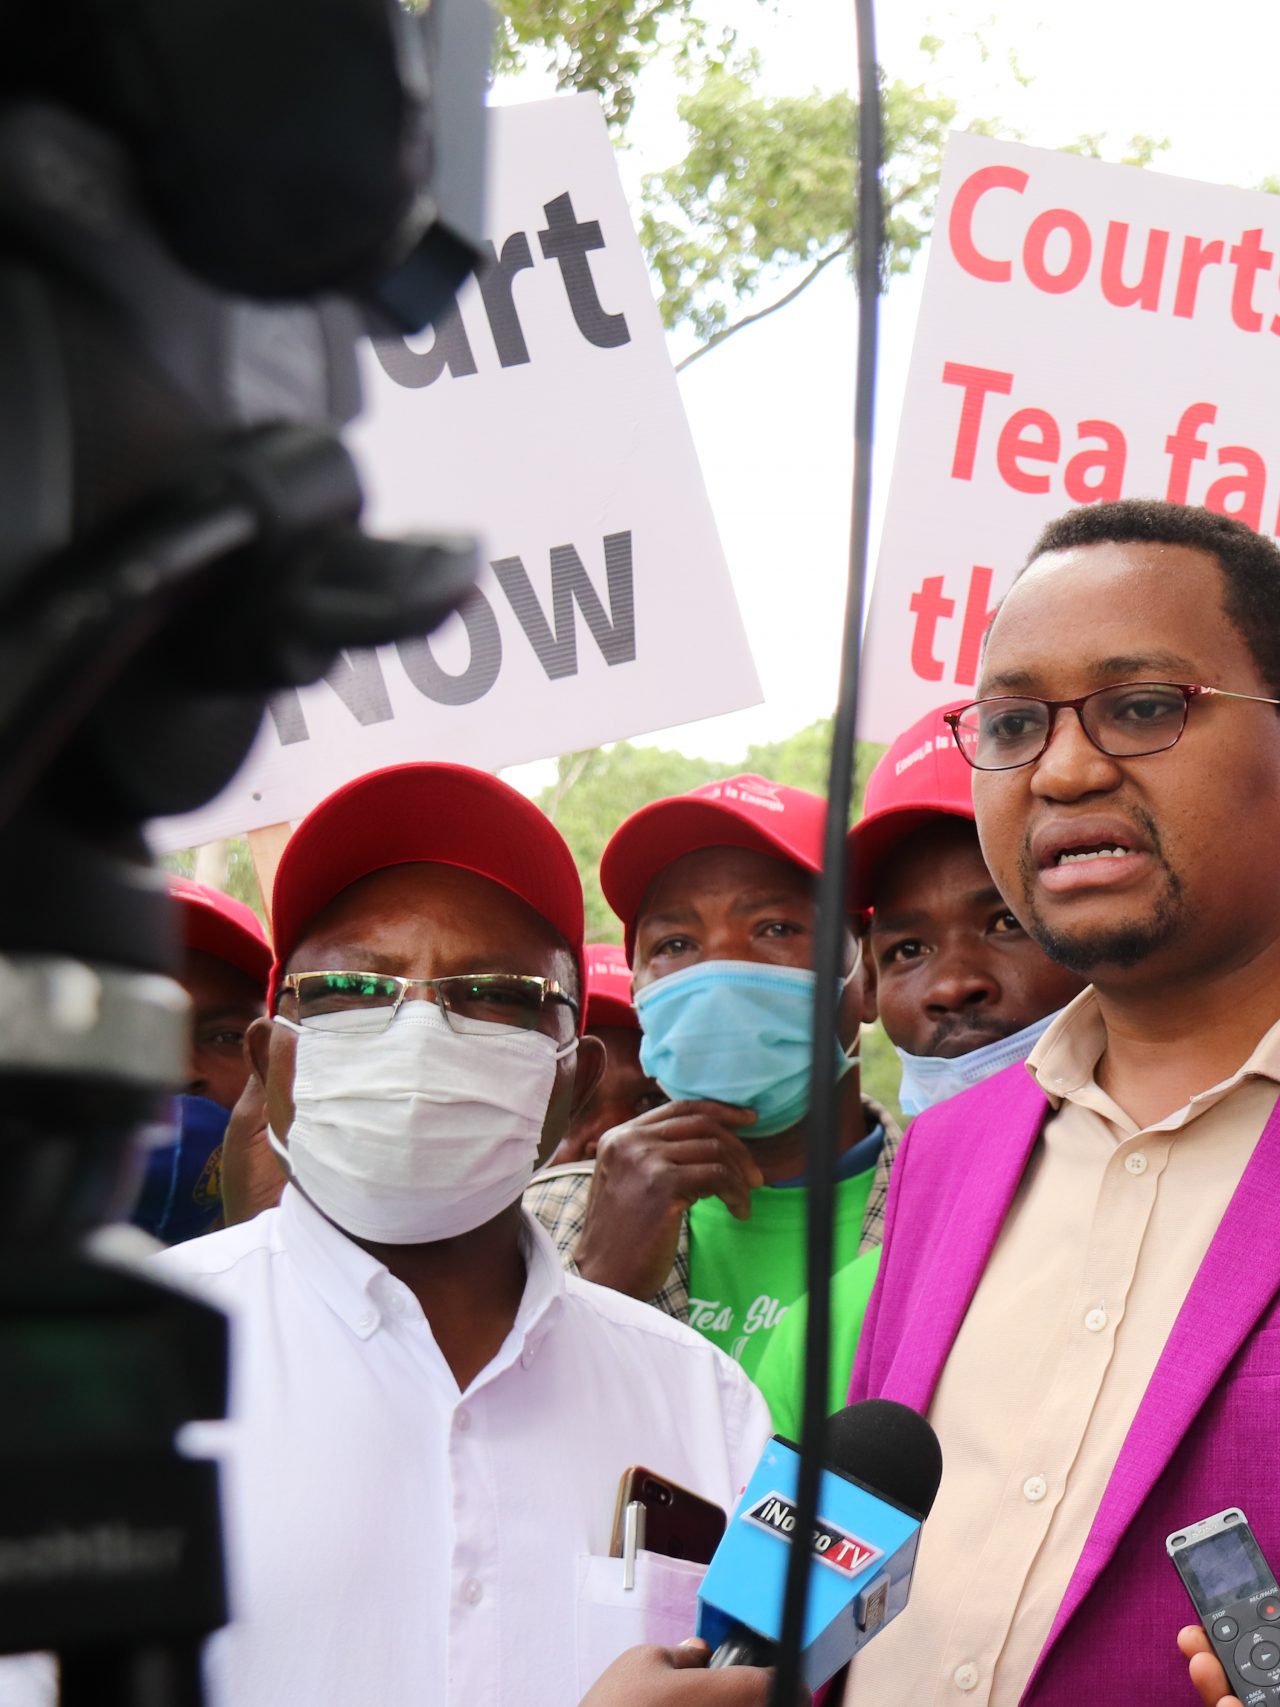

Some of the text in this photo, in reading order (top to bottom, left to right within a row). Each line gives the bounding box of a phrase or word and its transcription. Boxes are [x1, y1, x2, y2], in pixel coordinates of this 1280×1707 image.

[941, 361, 1129, 504] Tea
[688, 1297, 735, 1332] Tea
[836, 1538, 870, 1569] TV
[1212, 1609, 1226, 1620] STOP
